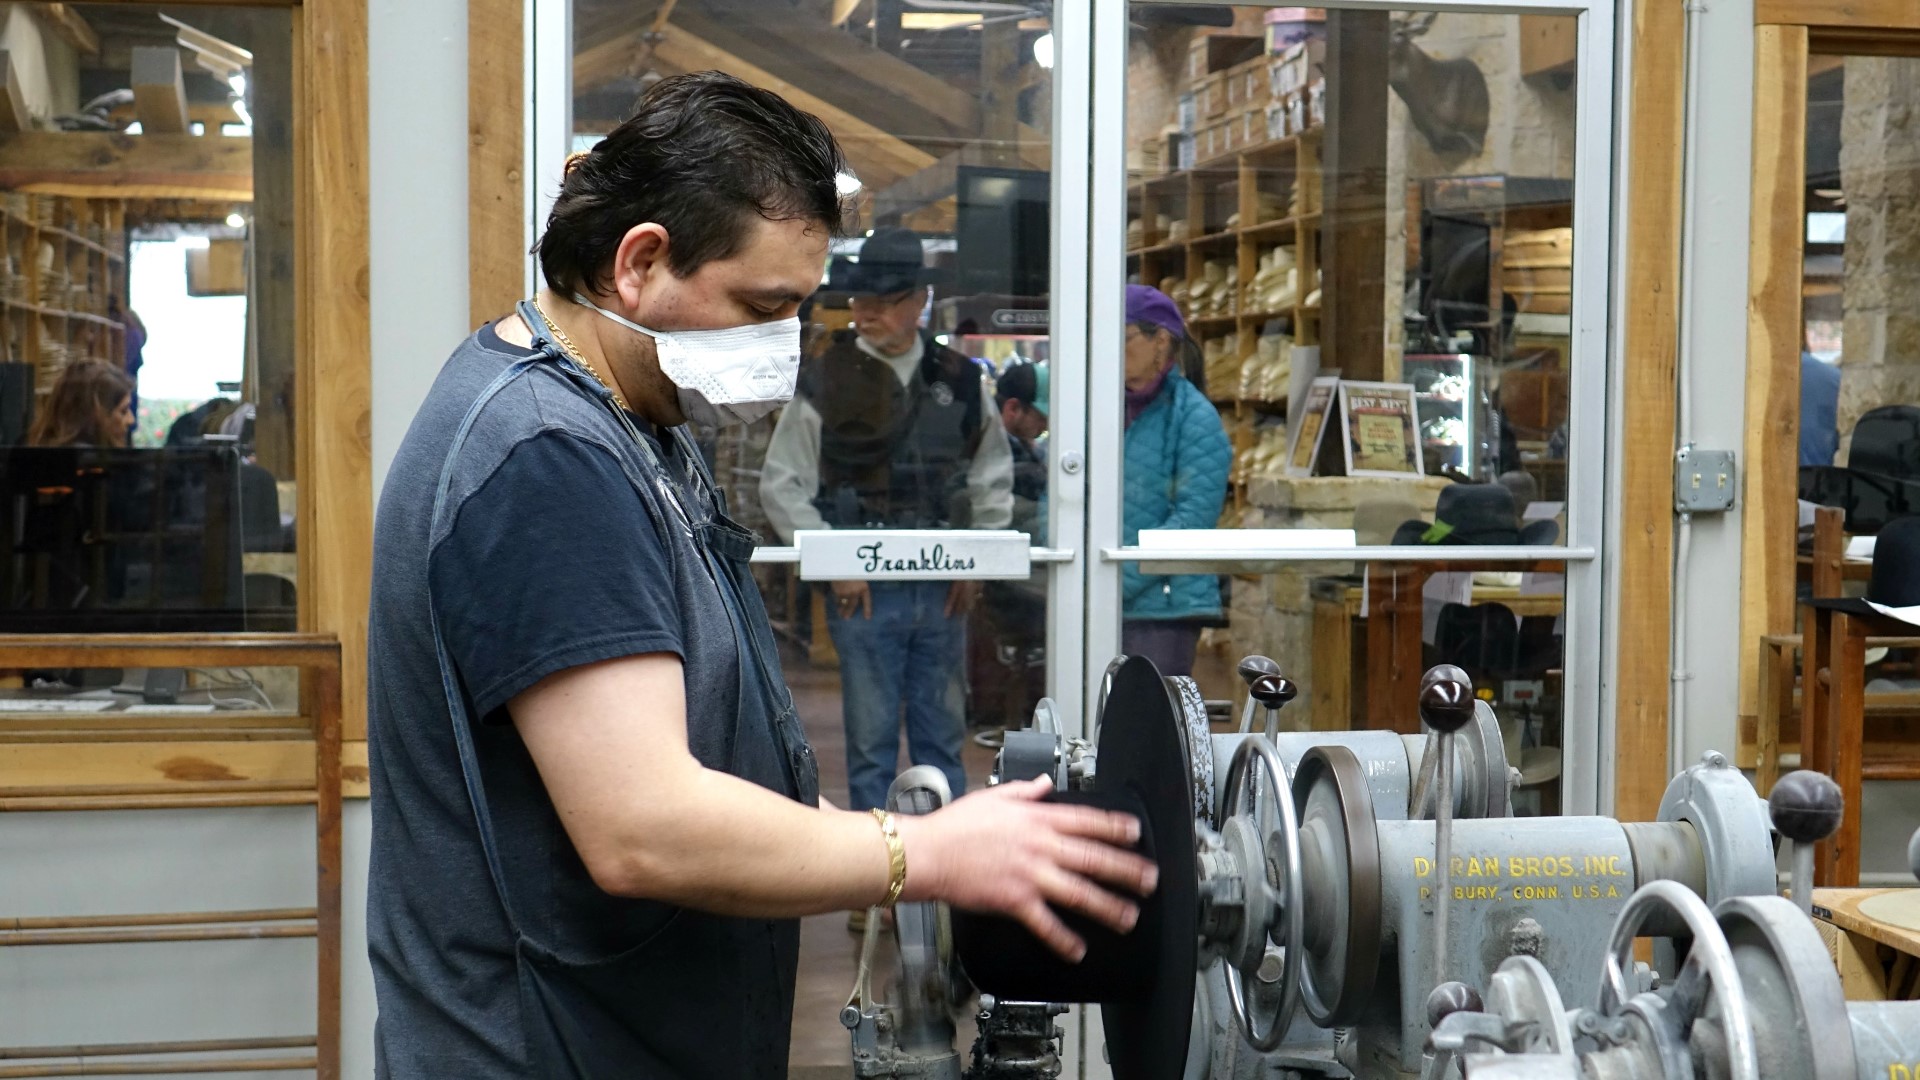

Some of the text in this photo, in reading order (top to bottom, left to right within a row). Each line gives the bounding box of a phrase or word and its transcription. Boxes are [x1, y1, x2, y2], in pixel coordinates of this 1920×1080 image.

[857, 541, 975, 573] Franklins
[1414, 855, 1627, 878] DRAN BROS. INC.
[1420, 885, 1623, 902] DBURY, CONN. U.S.A.
